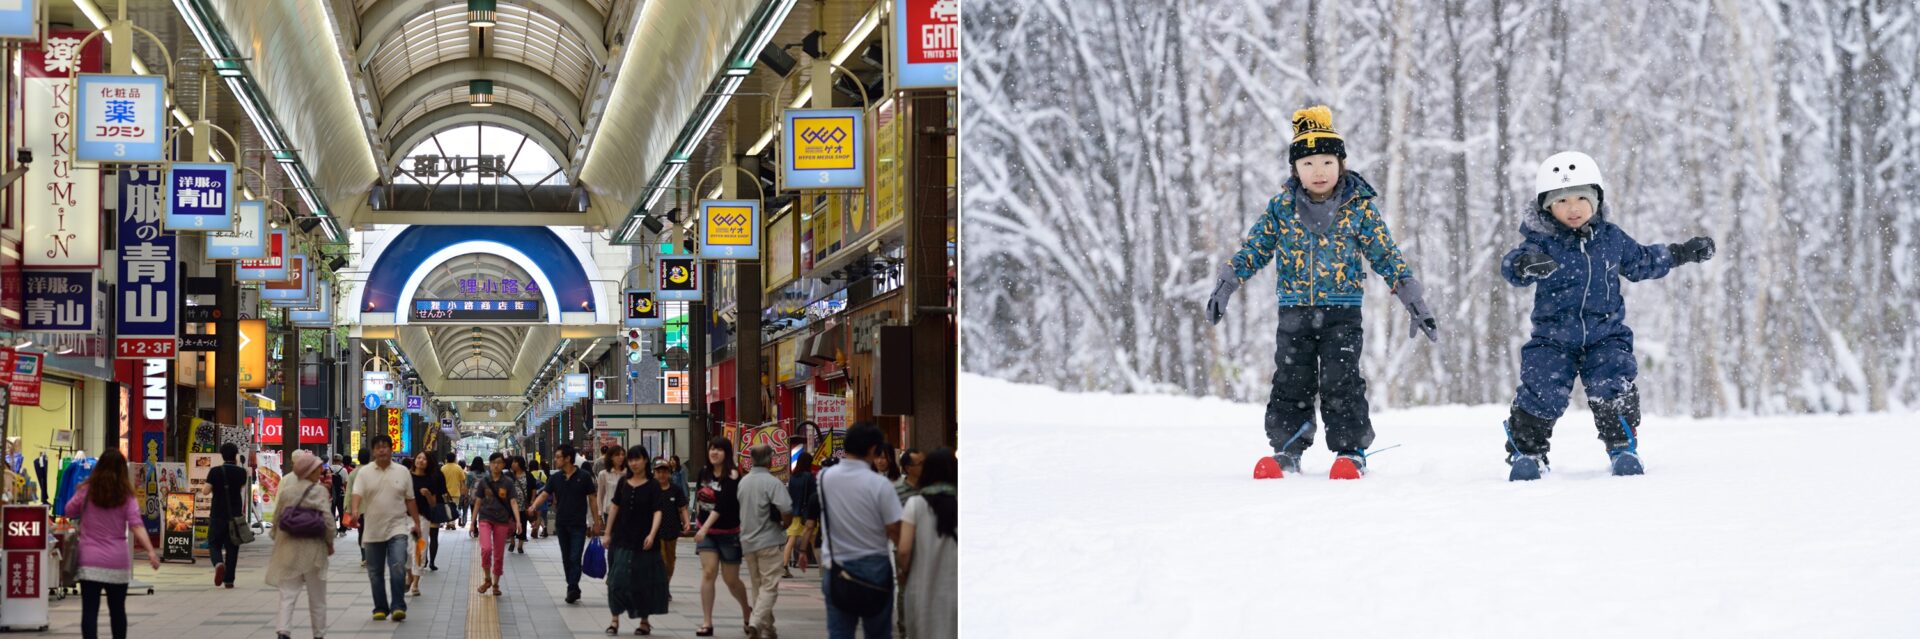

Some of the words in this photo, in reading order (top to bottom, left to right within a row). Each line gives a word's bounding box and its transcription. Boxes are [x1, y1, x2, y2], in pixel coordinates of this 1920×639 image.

[44, 37, 81, 72] 薬
[944, 64, 957, 81] 3
[100, 87, 140, 98] 化粧品
[105, 99, 135, 123] 薬
[96, 125, 144, 138] コクミン
[800, 126, 847, 144] GEO
[113, 143, 126, 157] 3
[824, 145, 843, 154] ゲオ
[178, 176, 221, 188] 洋服の
[819, 171, 830, 183] 3
[176, 188, 222, 208] 青山
[194, 216, 203, 226] 3
[712, 213, 747, 226] GEO
[231, 246, 239, 256] 3
[725, 246, 733, 256] 3
[258, 269, 266, 278] 3
[27, 277, 83, 294] 洋服の
[25, 298, 84, 326] 青山
[168, 536, 189, 545] OPEN
